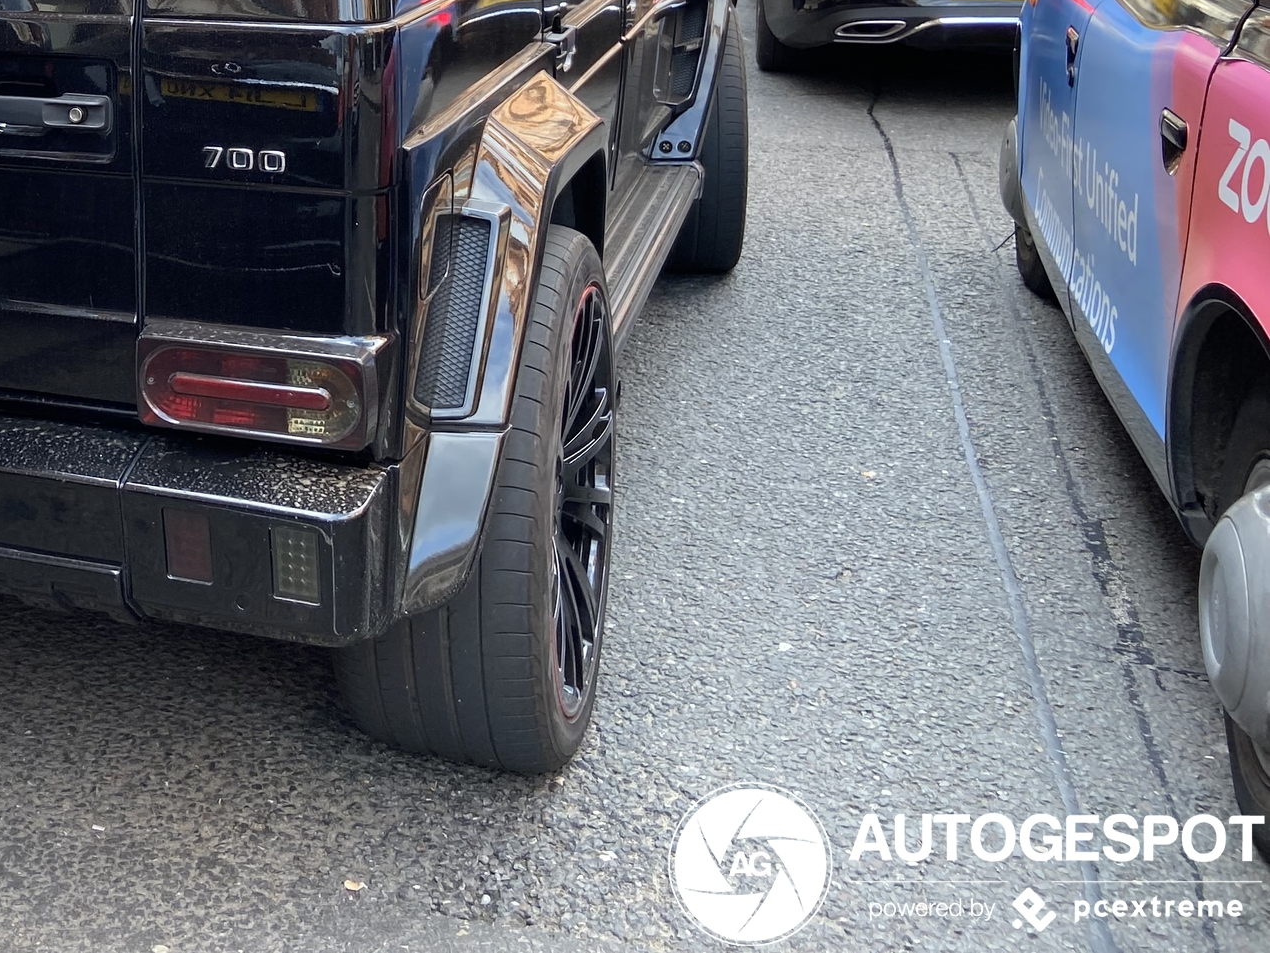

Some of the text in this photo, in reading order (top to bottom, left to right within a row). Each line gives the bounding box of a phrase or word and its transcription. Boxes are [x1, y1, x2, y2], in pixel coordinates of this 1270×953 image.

[201, 146, 286, 173] 700
[1039, 75, 1139, 267] Video-First Unified
[1034, 166, 1118, 355] Communications
